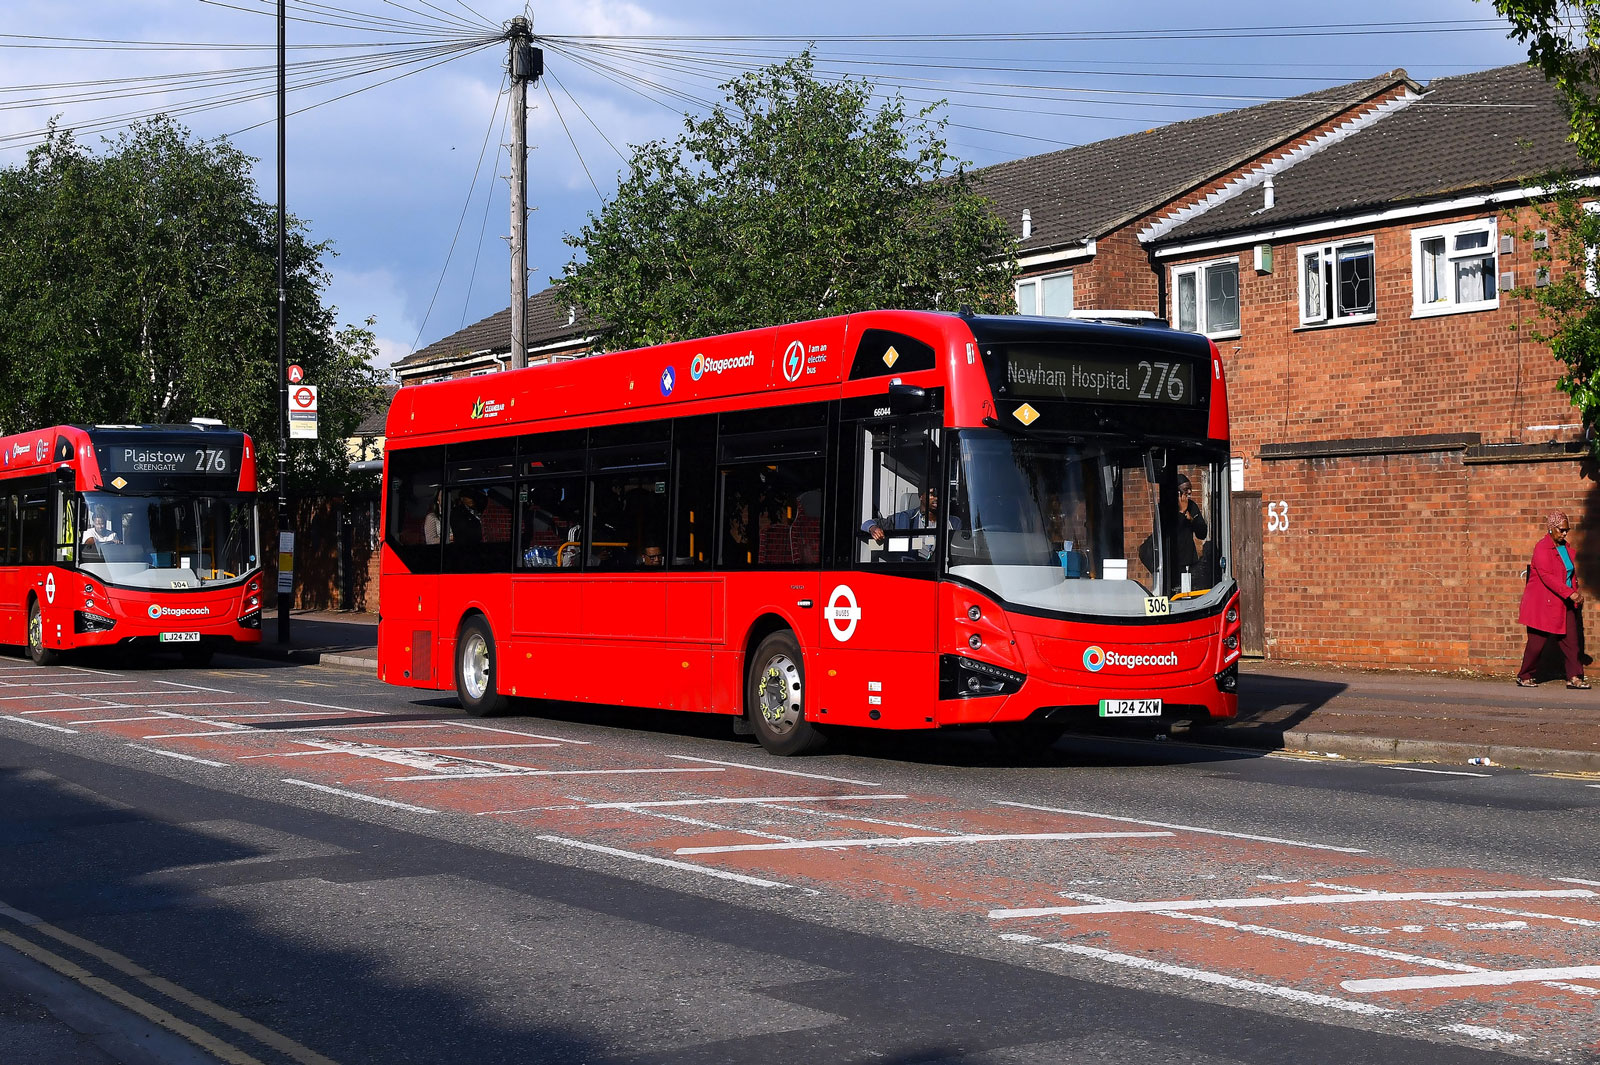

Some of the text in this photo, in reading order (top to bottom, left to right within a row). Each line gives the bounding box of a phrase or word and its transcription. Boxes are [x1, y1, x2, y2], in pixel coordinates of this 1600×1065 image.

[704, 350, 755, 374] Stagecoach
[807, 354, 827, 364] electric
[290, 367, 302, 381] A
[806, 366, 817, 375] bus
[1007, 360, 1185, 402] Newham Hospital 276
[874, 407, 891, 417] 66044
[124, 448, 227, 472] Plaistow 276
[133, 463, 177, 472] GREENGATE
[1267, 500, 1290, 532] 53
[173, 581, 187, 589] 304
[161, 606, 210, 617] Stagecoach
[1148, 599, 1167, 614] 306
[836, 609, 850, 617] BUSES
[163, 632, 199, 642] LJ24 ZKT
[1105, 651, 1178, 669] Stagecoach
[1106, 701, 1161, 715] LJ24 ZKW
